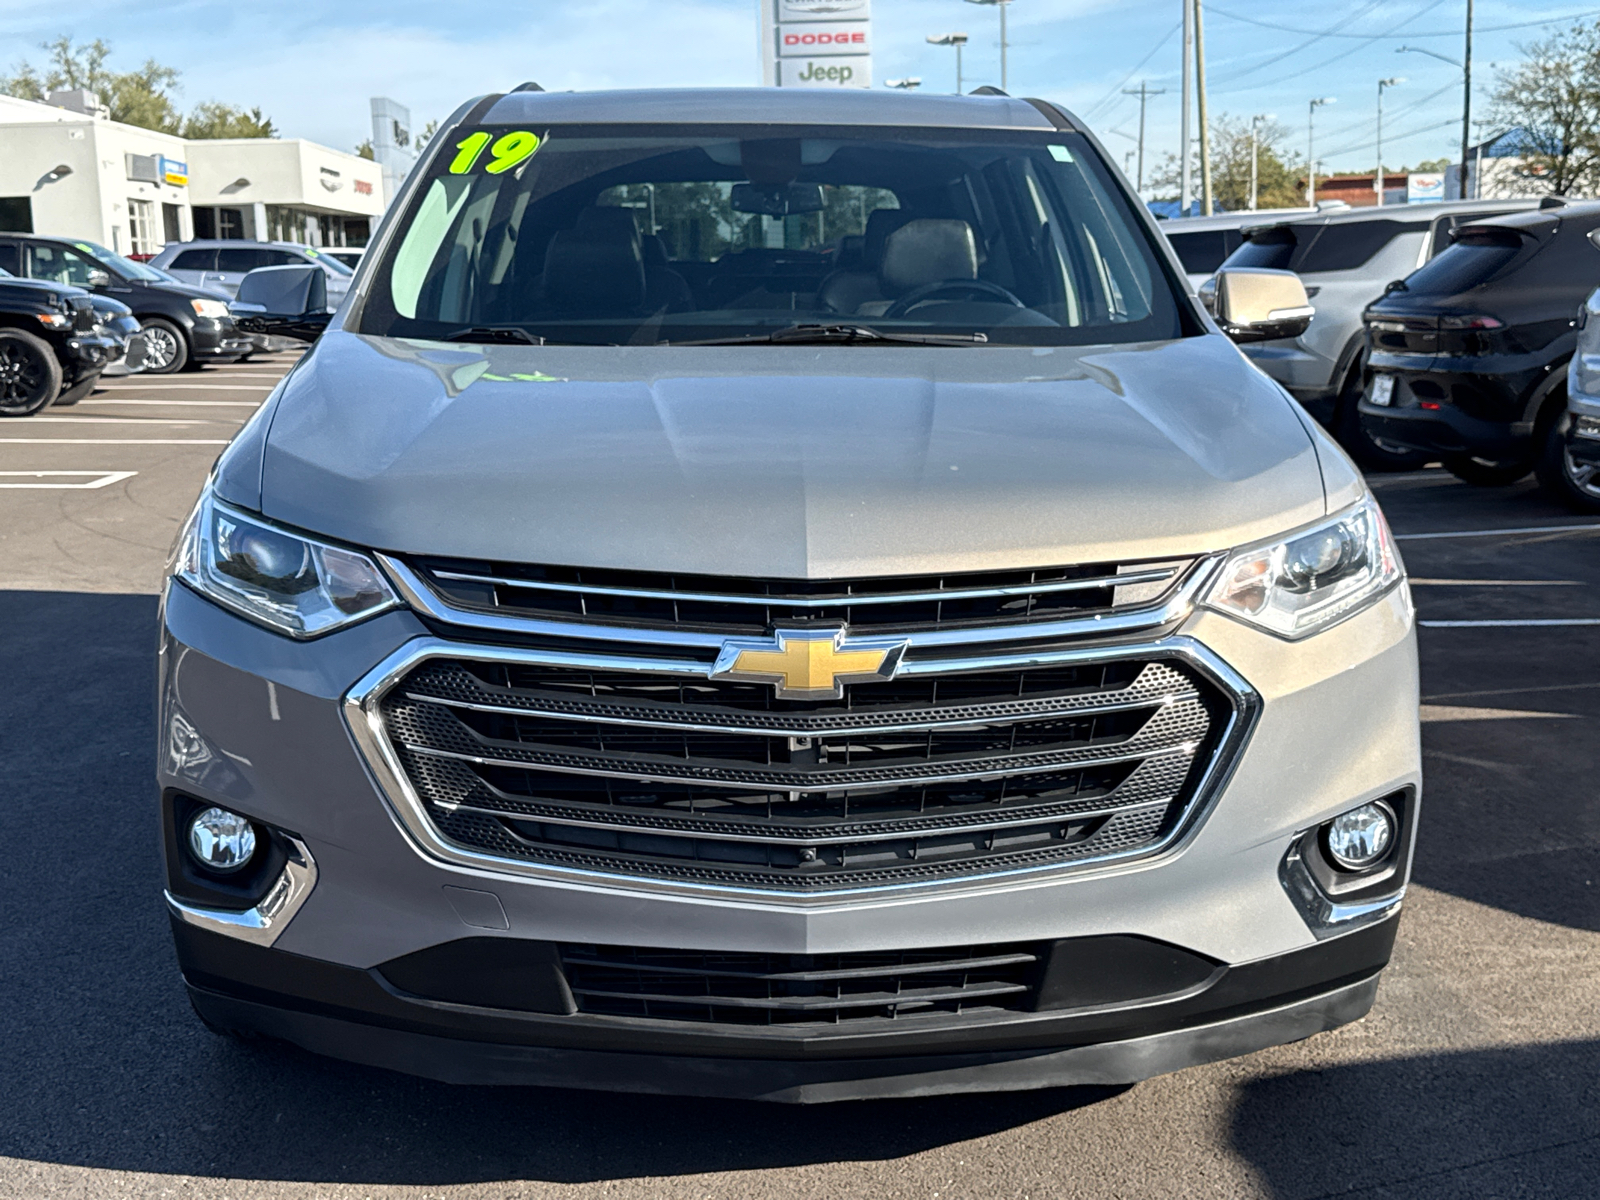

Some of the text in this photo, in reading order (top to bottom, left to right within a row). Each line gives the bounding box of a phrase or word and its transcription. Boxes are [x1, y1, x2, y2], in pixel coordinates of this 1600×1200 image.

[784, 33, 865, 45] DODGE
[798, 61, 853, 84] Jeep
[449, 131, 540, 174] 19
